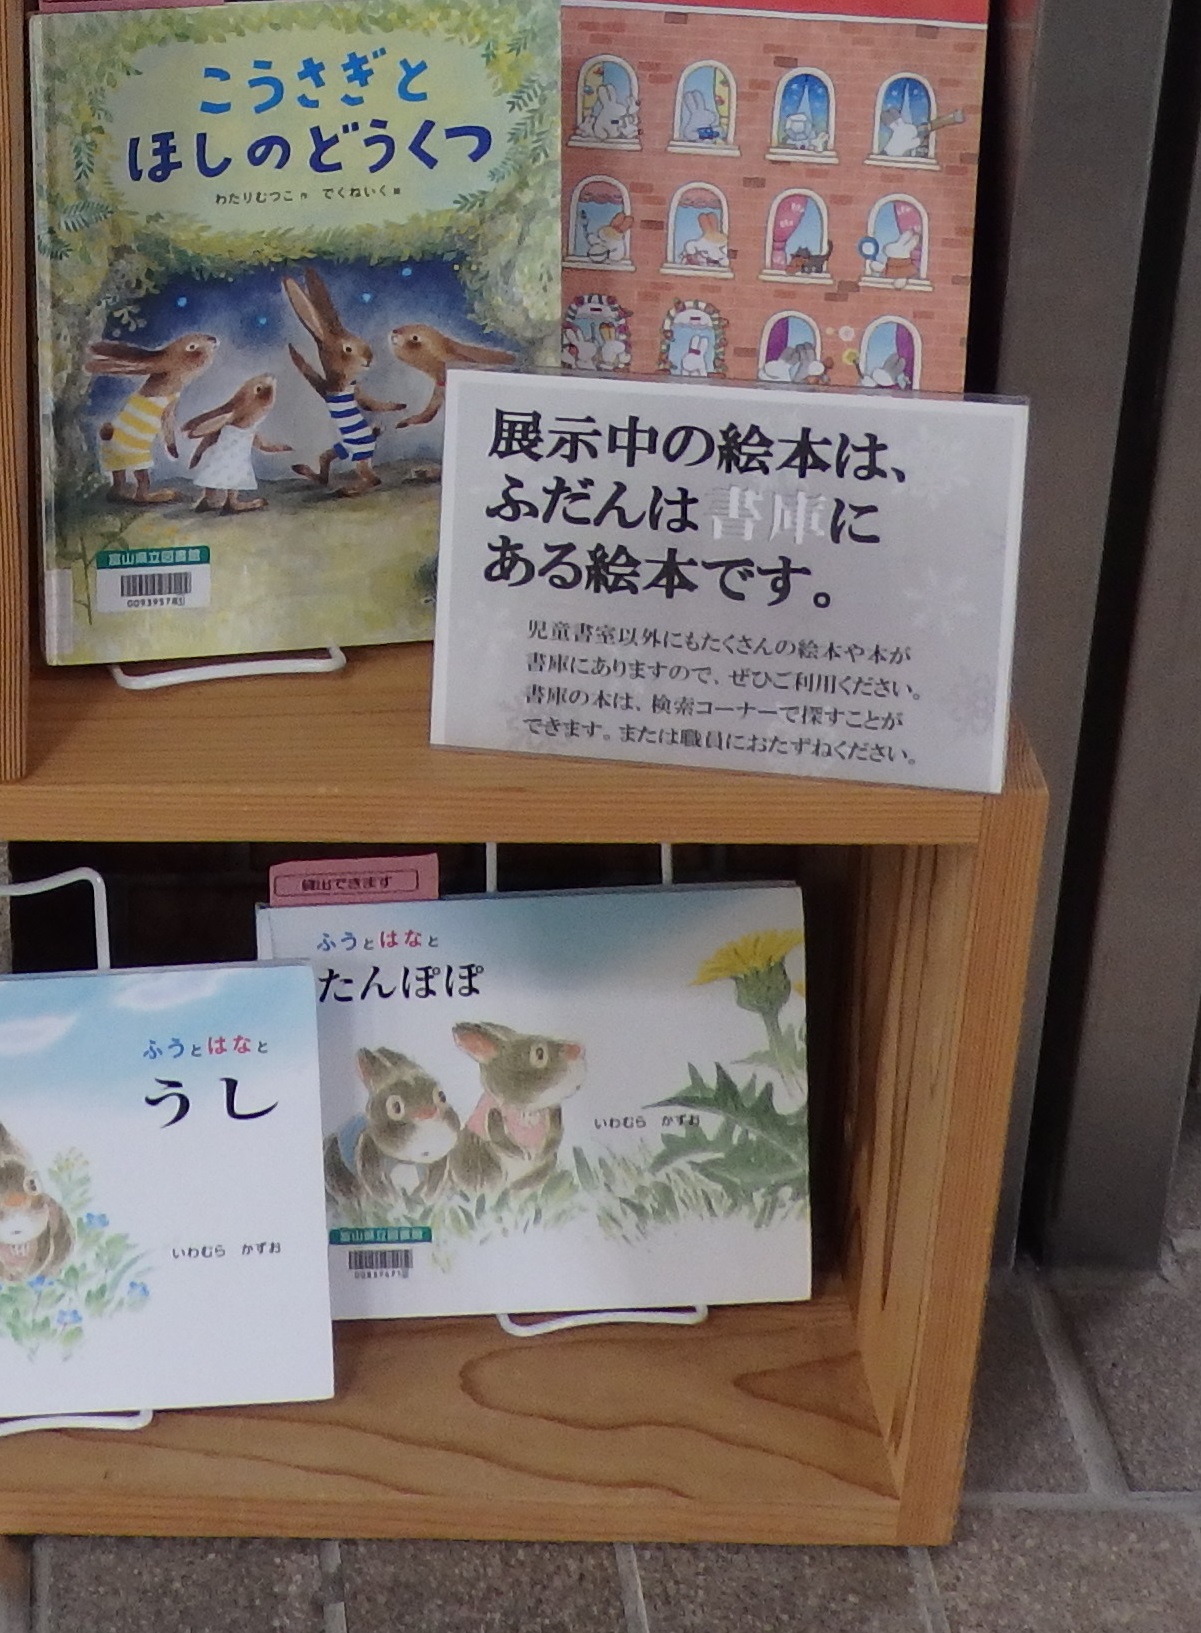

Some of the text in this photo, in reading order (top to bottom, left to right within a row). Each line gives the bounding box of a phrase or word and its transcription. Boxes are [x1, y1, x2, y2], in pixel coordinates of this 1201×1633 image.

[199, 47, 429, 115] こうさぎと
[128, 118, 493, 183] ほしのどうくつ
[214, 185, 388, 206] わたりむつこ でくねいく
[489, 409, 906, 483] 展示中の絵本は、
[485, 473, 881, 545] ふだんは書庫に
[108, 548, 201, 567] 富山県立図書館
[484, 534, 831, 609] ある絵本です。
[527, 618, 912, 666] 児童書室以外にもたくさんの絵本や本が
[316, 928, 440, 952] ふうとはなと
[317, 963, 485, 1003] たんぽぽ
[143, 1034, 269, 1060] ふうとはなと
[144, 1076, 279, 1129] うし
[171, 1240, 282, 1261] いわむら かずお
